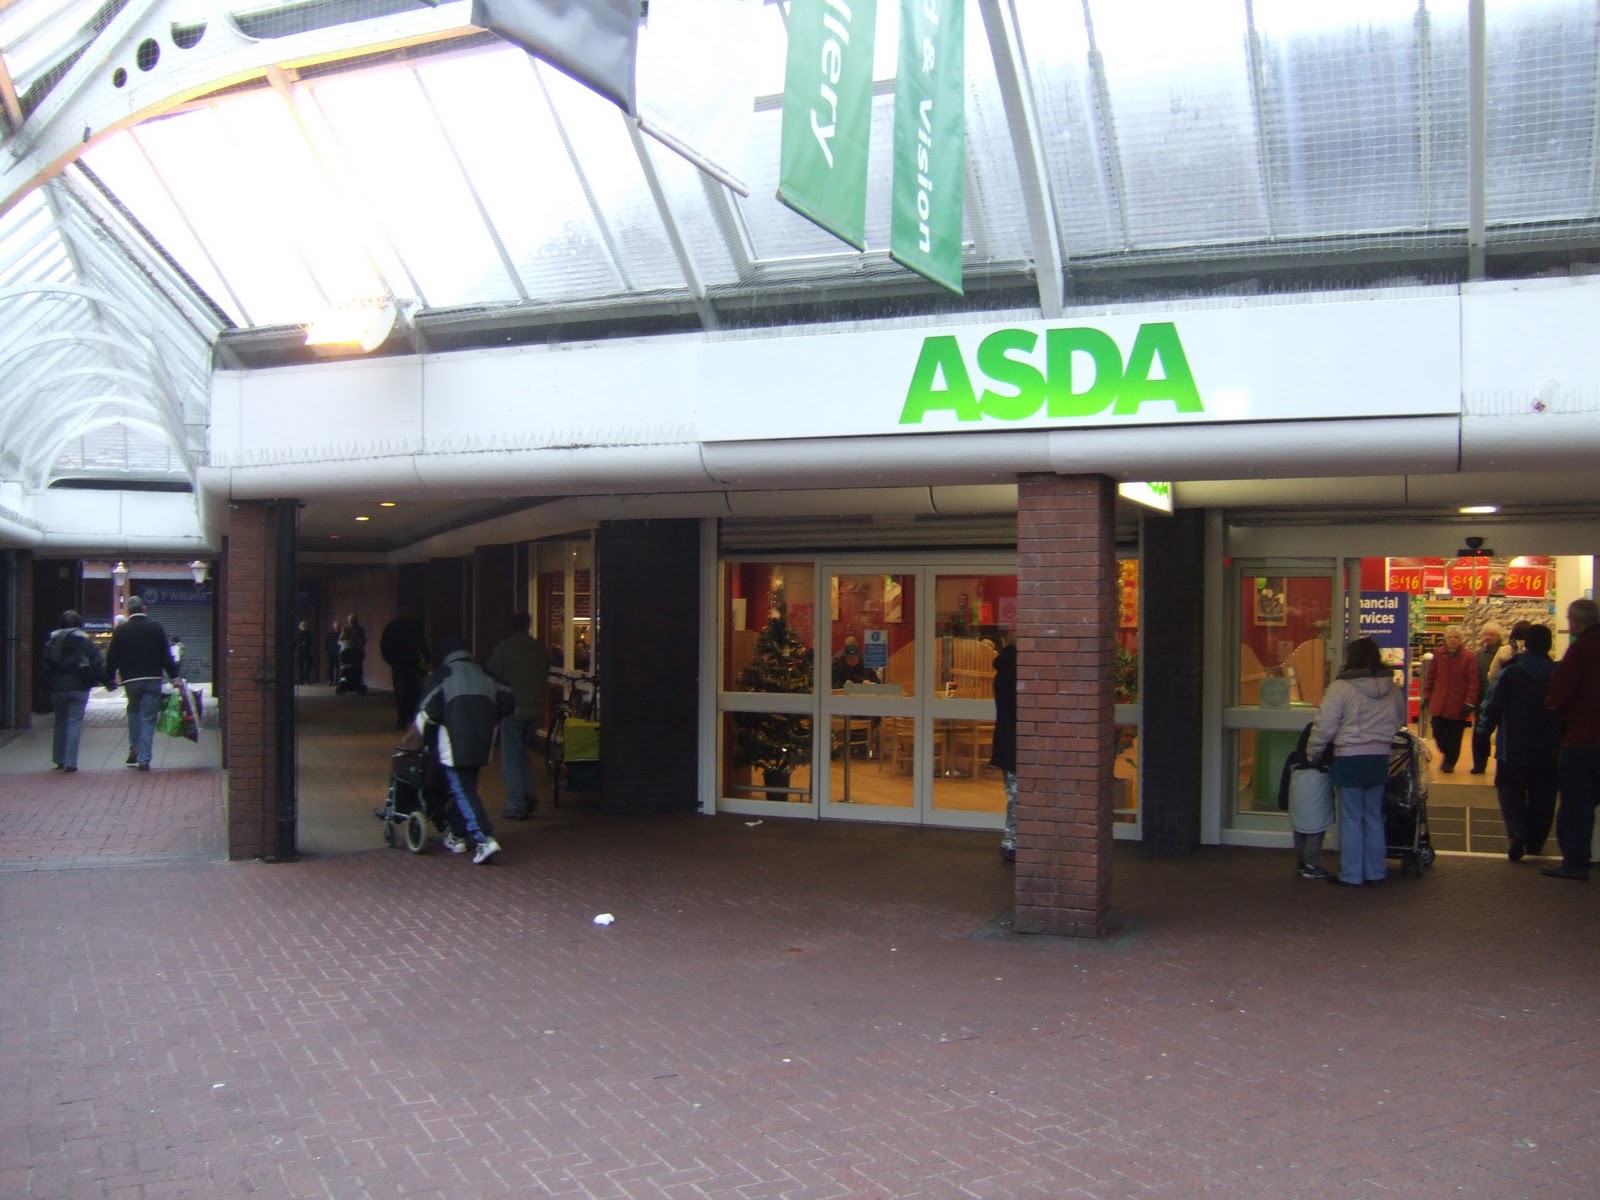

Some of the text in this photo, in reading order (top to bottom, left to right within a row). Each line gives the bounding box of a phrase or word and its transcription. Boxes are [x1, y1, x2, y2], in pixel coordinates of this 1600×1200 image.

[922, 37, 935, 74] &
[918, 99, 933, 253] vision
[899, 322, 1205, 424] ASDA
[1401, 575, 1420, 590] £16
[1462, 575, 1483, 590] £16
[1520, 574, 1541, 590] £16
[1345, 597, 1398, 608] nancial
[1345, 612, 1395, 624] rvices
